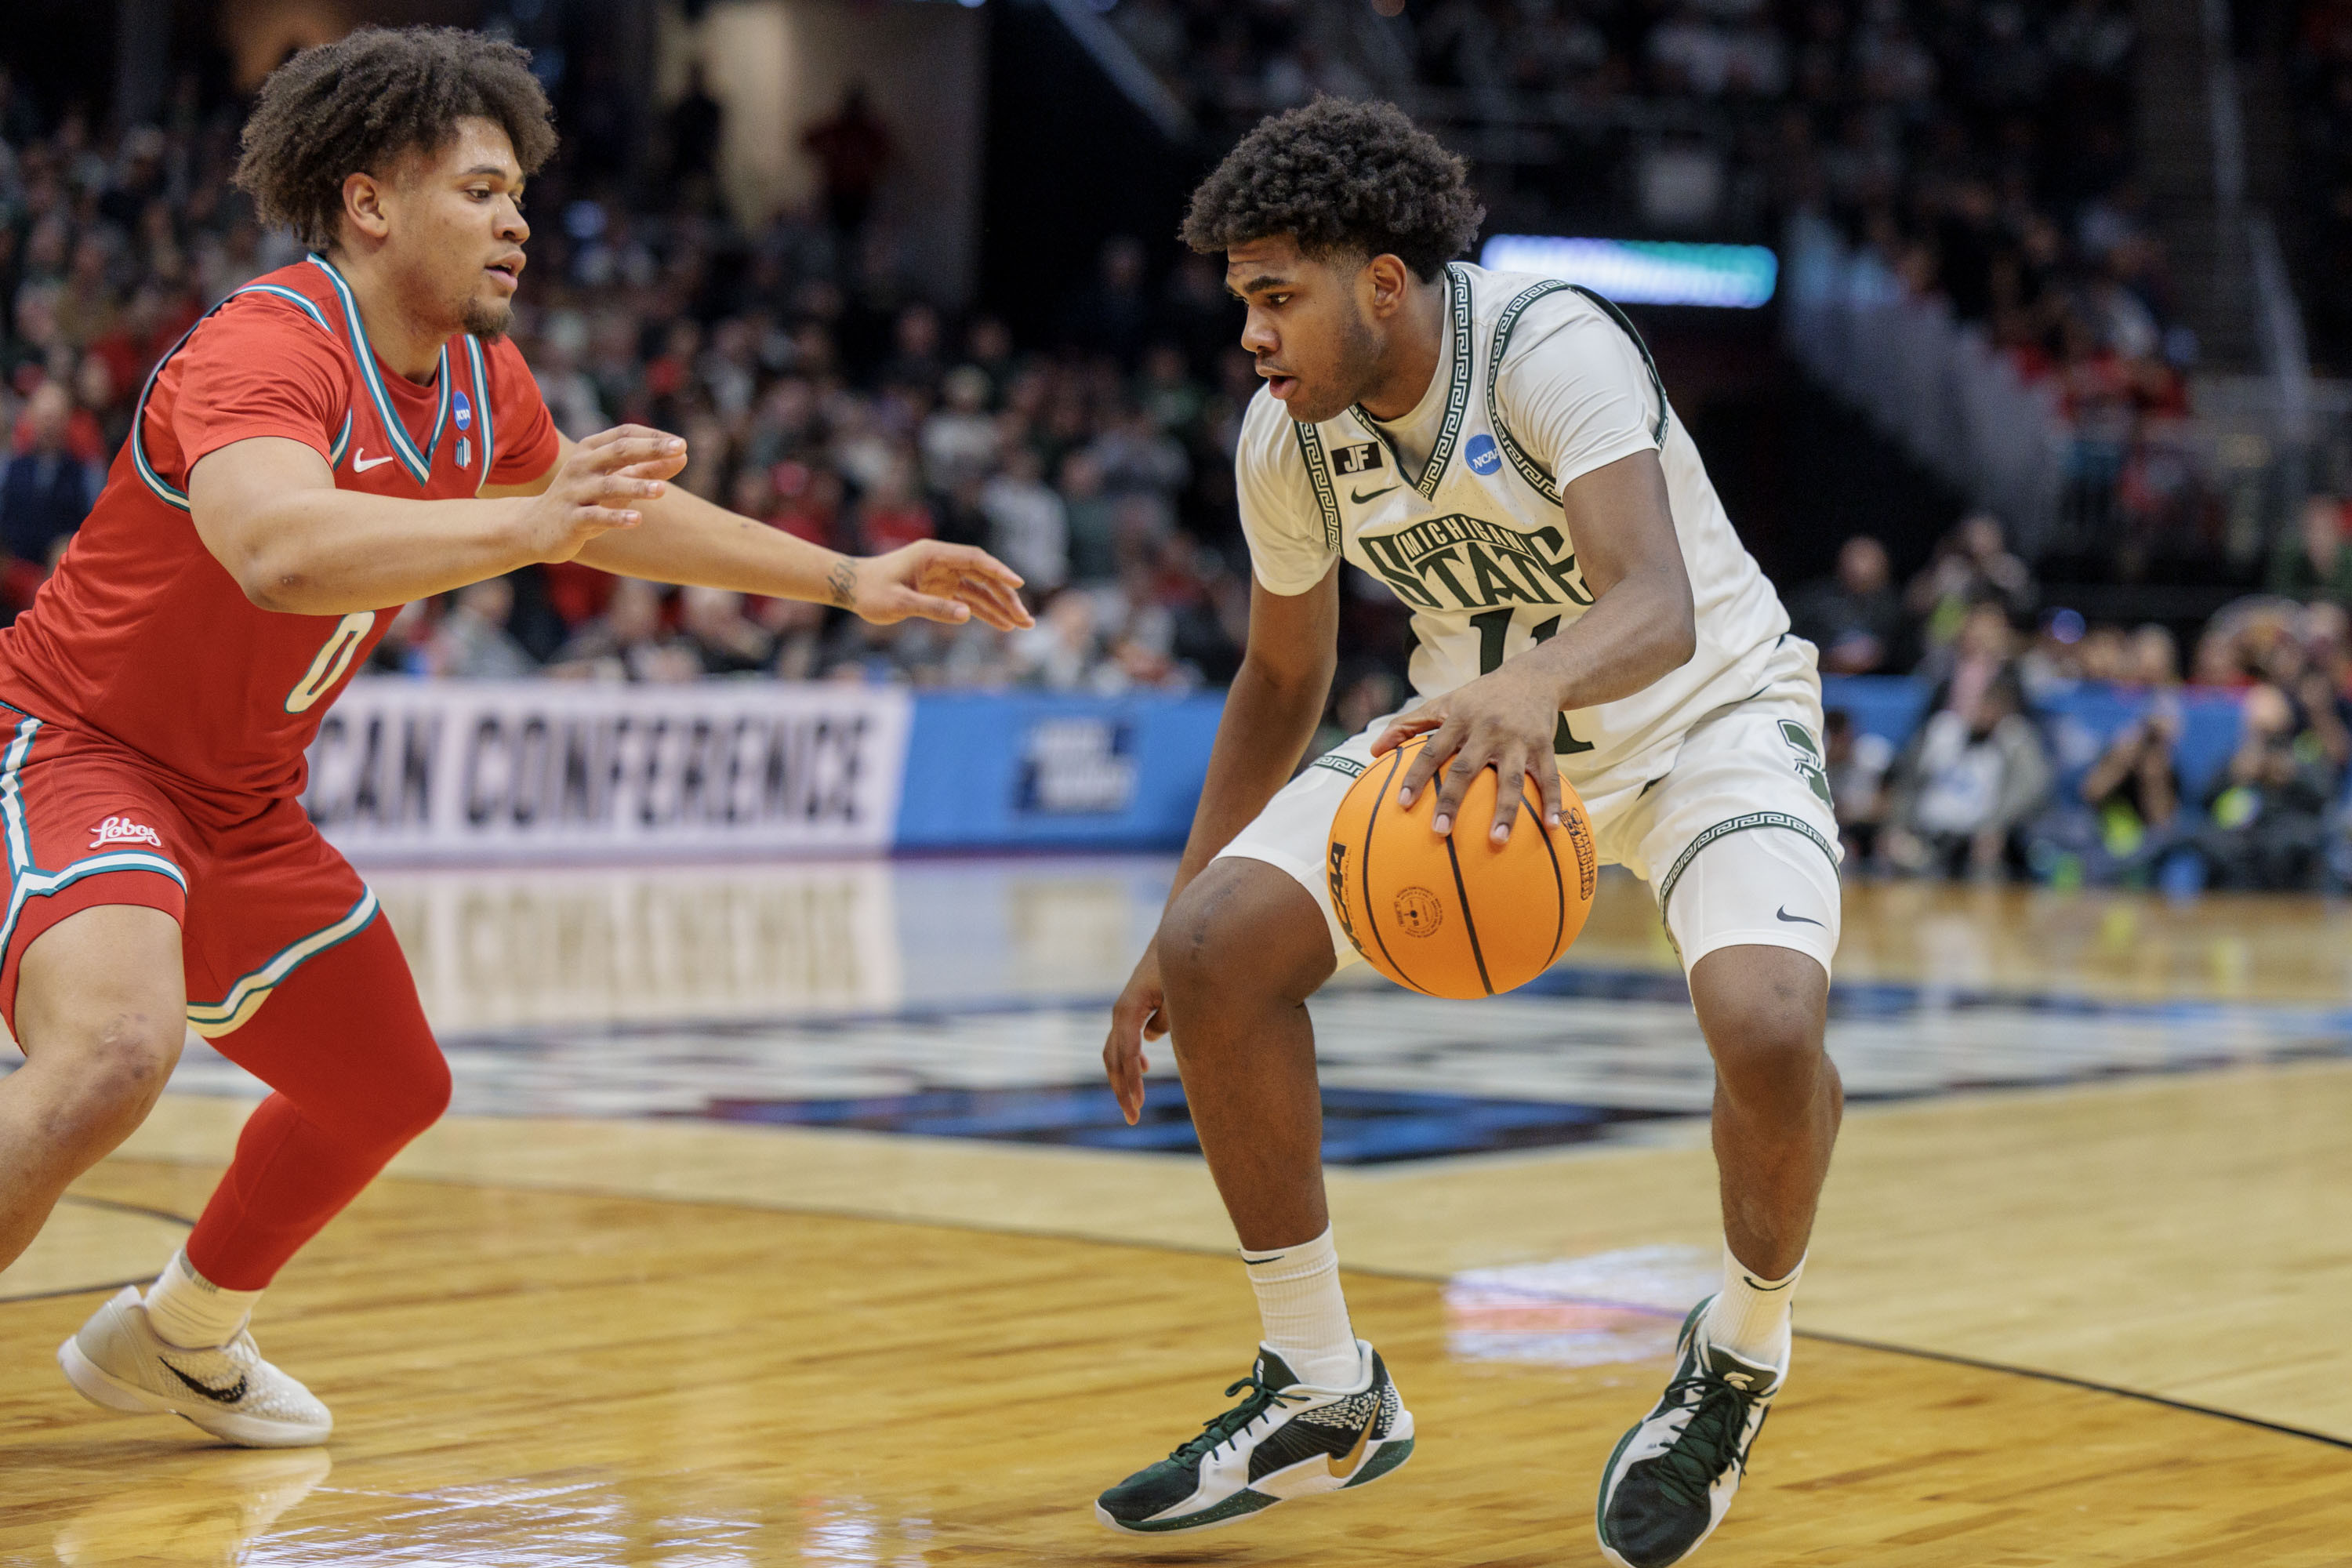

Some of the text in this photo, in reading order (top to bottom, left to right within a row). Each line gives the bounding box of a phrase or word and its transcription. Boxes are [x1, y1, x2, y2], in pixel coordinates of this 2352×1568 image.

[1344, 445, 1369, 473] JF
[1358, 526, 1596, 609] STATE
[1399, 516, 1527, 559] MICHIGAN
[284, 610, 376, 714] 0
[466, 710, 870, 827] CONFERENCE
[89, 816, 162, 848] Lobos
